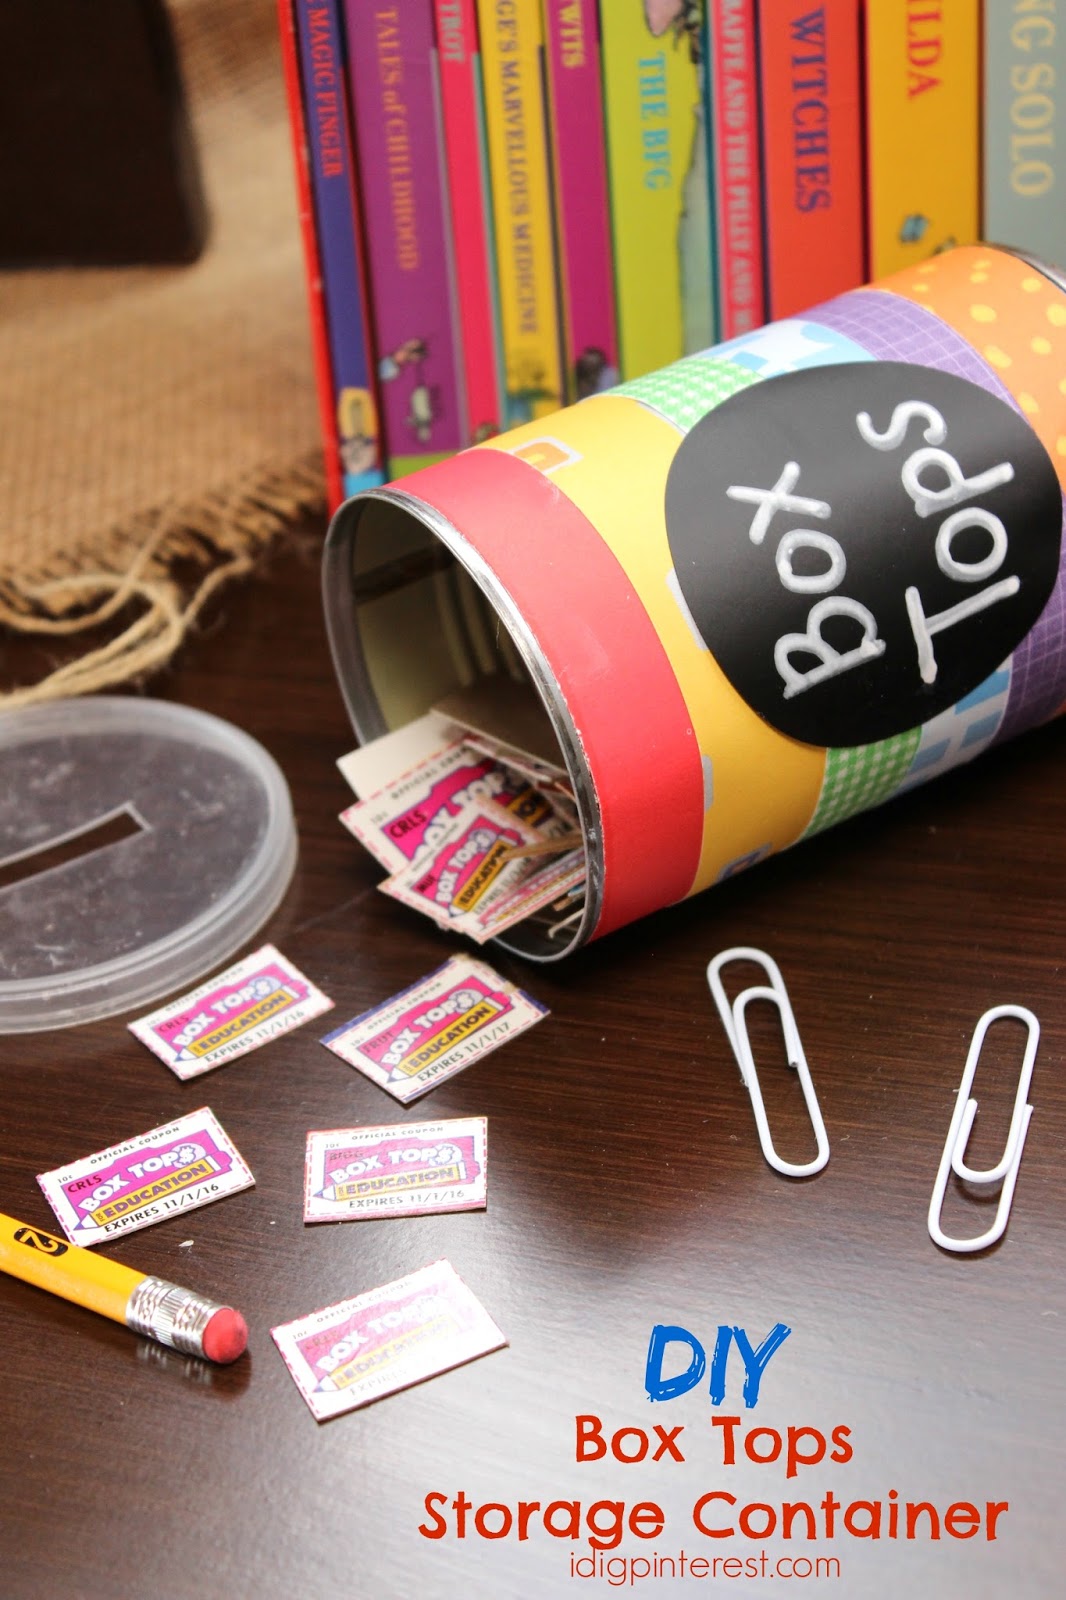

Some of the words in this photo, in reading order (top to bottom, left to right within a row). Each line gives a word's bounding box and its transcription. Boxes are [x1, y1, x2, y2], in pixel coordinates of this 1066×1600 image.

[308, 8, 336, 87] MAGIC
[375, 8, 405, 85] TALES
[639, 52, 669, 121] THE
[789, 8, 831, 214] WITCHES
[316, 91, 344, 178] FINGER
[1009, 63, 1057, 197] SOLO
[642, 129, 672, 191] BFG
[856, 400, 1021, 684] Tops
[726, 461, 886, 700] Box
[389, 810, 427, 839] CRLS
[158, 1015, 189, 1034] CRLS
[171, 1012, 217, 1046] BOX
[199, 995, 286, 1050] EDUCATION
[204, 1037, 254, 1063] EXPIRES
[256, 1010, 305, 1038] 11/1/16
[381, 1027, 422, 1066] BOX
[408, 1006, 491, 1068] EDUCATION
[417, 1051, 465, 1082] EXPIRES
[466, 1022, 511, 1053] 11/1/17
[90, 1145, 136, 1165] OFFICIAL
[138, 1126, 180, 1145] COUPON
[351, 1131, 397, 1141] OFFICIAL
[401, 1126, 445, 1136] COUPON
[67, 1174, 102, 1193] CRLS
[77, 1173, 131, 1213] BOX
[103, 1163, 209, 1218] EDUCATION
[328, 1155, 385, 1185] BOX
[345, 1167, 455, 1195] EDUCATION
[104, 1206, 160, 1233] EXPIRES
[163, 1183, 220, 1210] 11/1/16
[348, 1195, 404, 1209] EXPIRES
[409, 1189, 466, 1204] 11/1/16
[19, 1229, 59, 1253] 2
[316, 1301, 364, 1323] OFFICIAL
[315, 1329, 370, 1373] BOX
